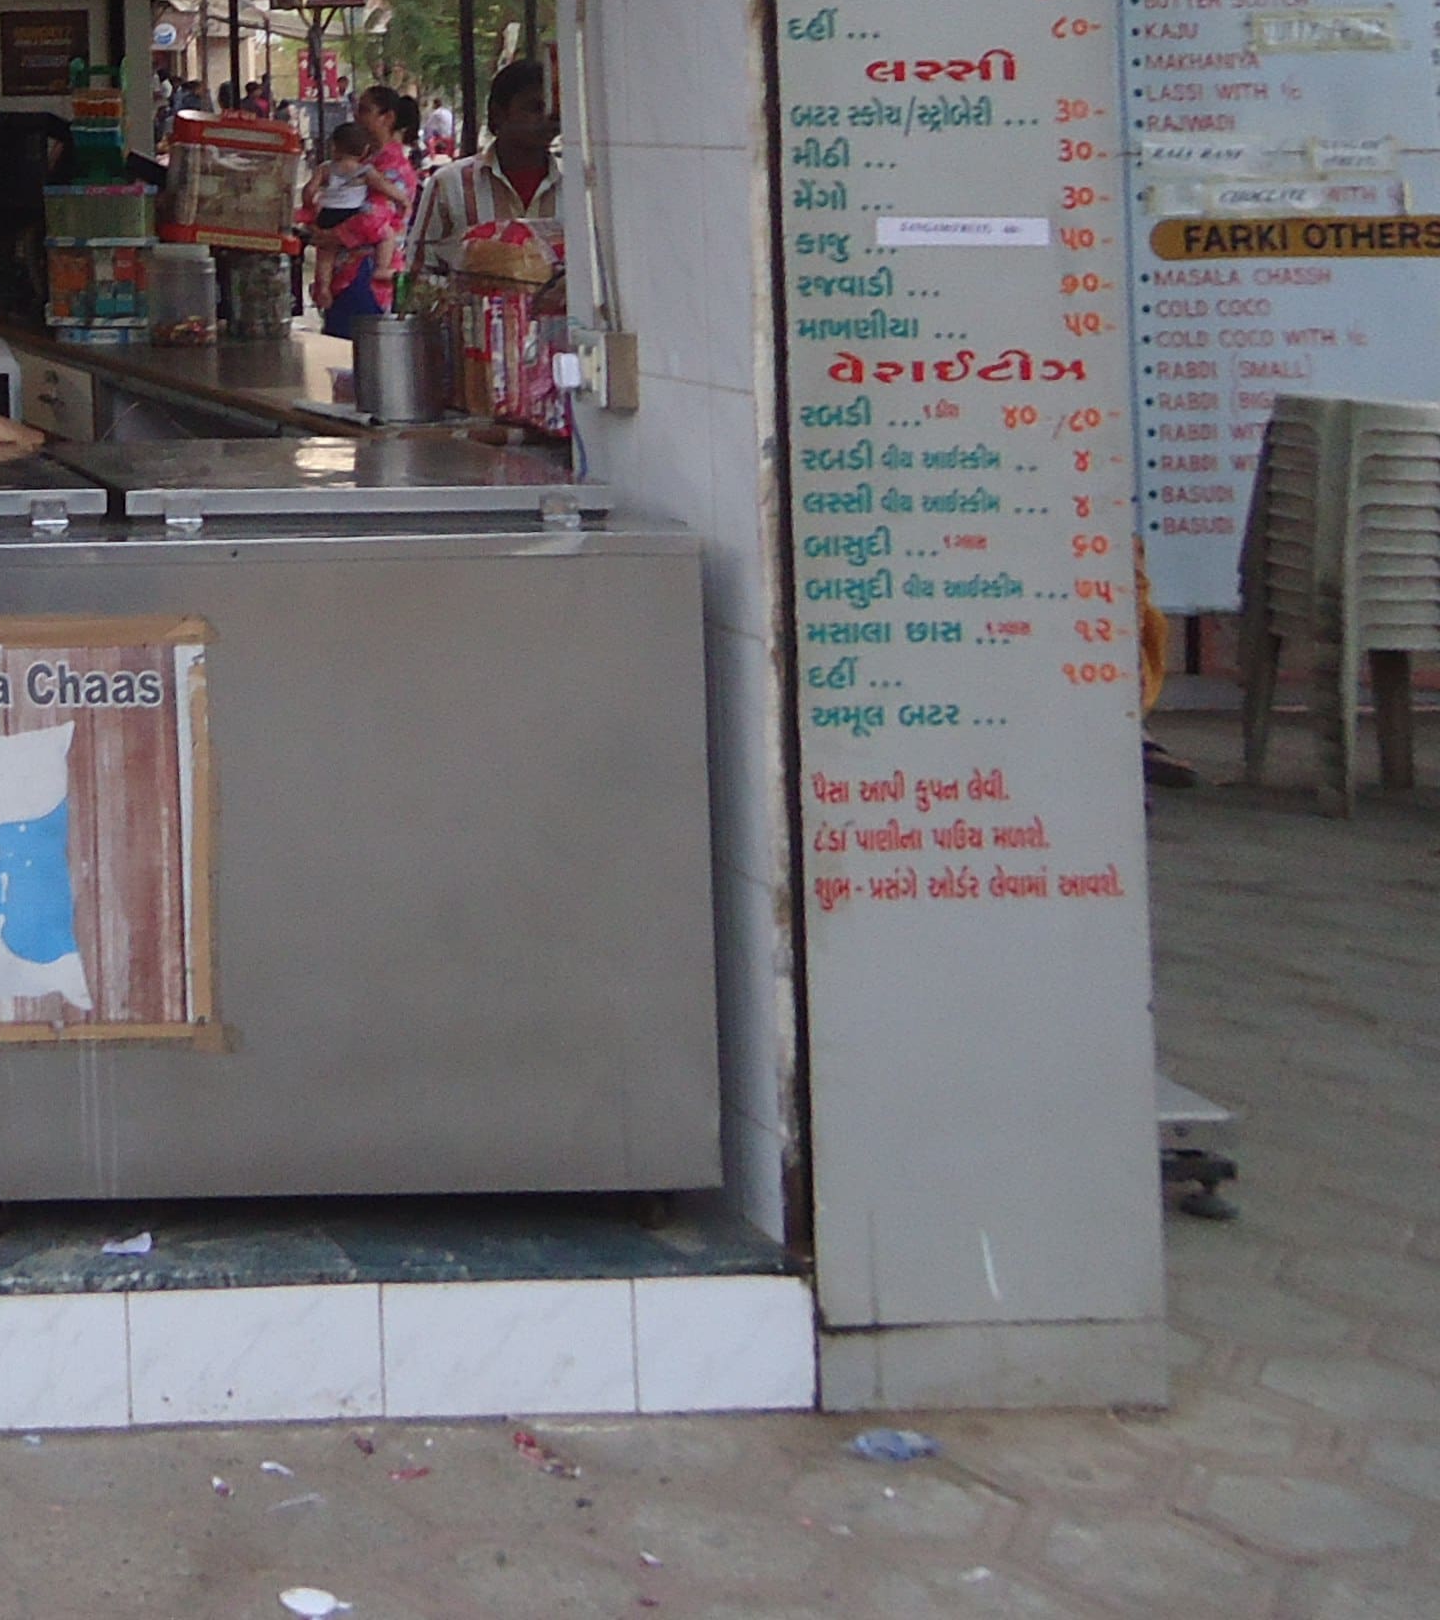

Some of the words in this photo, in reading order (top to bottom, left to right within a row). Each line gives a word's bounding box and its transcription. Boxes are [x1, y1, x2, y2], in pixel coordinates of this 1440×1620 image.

[1144, 22, 1199, 40] KAJU
[865, 48, 1017, 83] લસ્સી
[1146, 82, 1204, 102] LASSI
[1215, 81, 1269, 100] WITH
[792, 135, 851, 168] મીઠી
[794, 232, 850, 262] કાજુ
[1183, 224, 1288, 253] FARKI
[796, 265, 894, 298] રજવાડી
[1153, 267, 1242, 286] MASALA
[1155, 298, 1208, 317] COLD
[1155, 329, 1209, 349] COLD
[800, 395, 872, 428] રબડી
[800, 438, 873, 471] રબડી
[803, 525, 892, 567] બાસુદી
[804, 568, 894, 610] બાસુદી
[806, 619, 891, 644] મસાલા
[26, 663, 162, 707] Chaas
[898, 703, 961, 727] બટર
